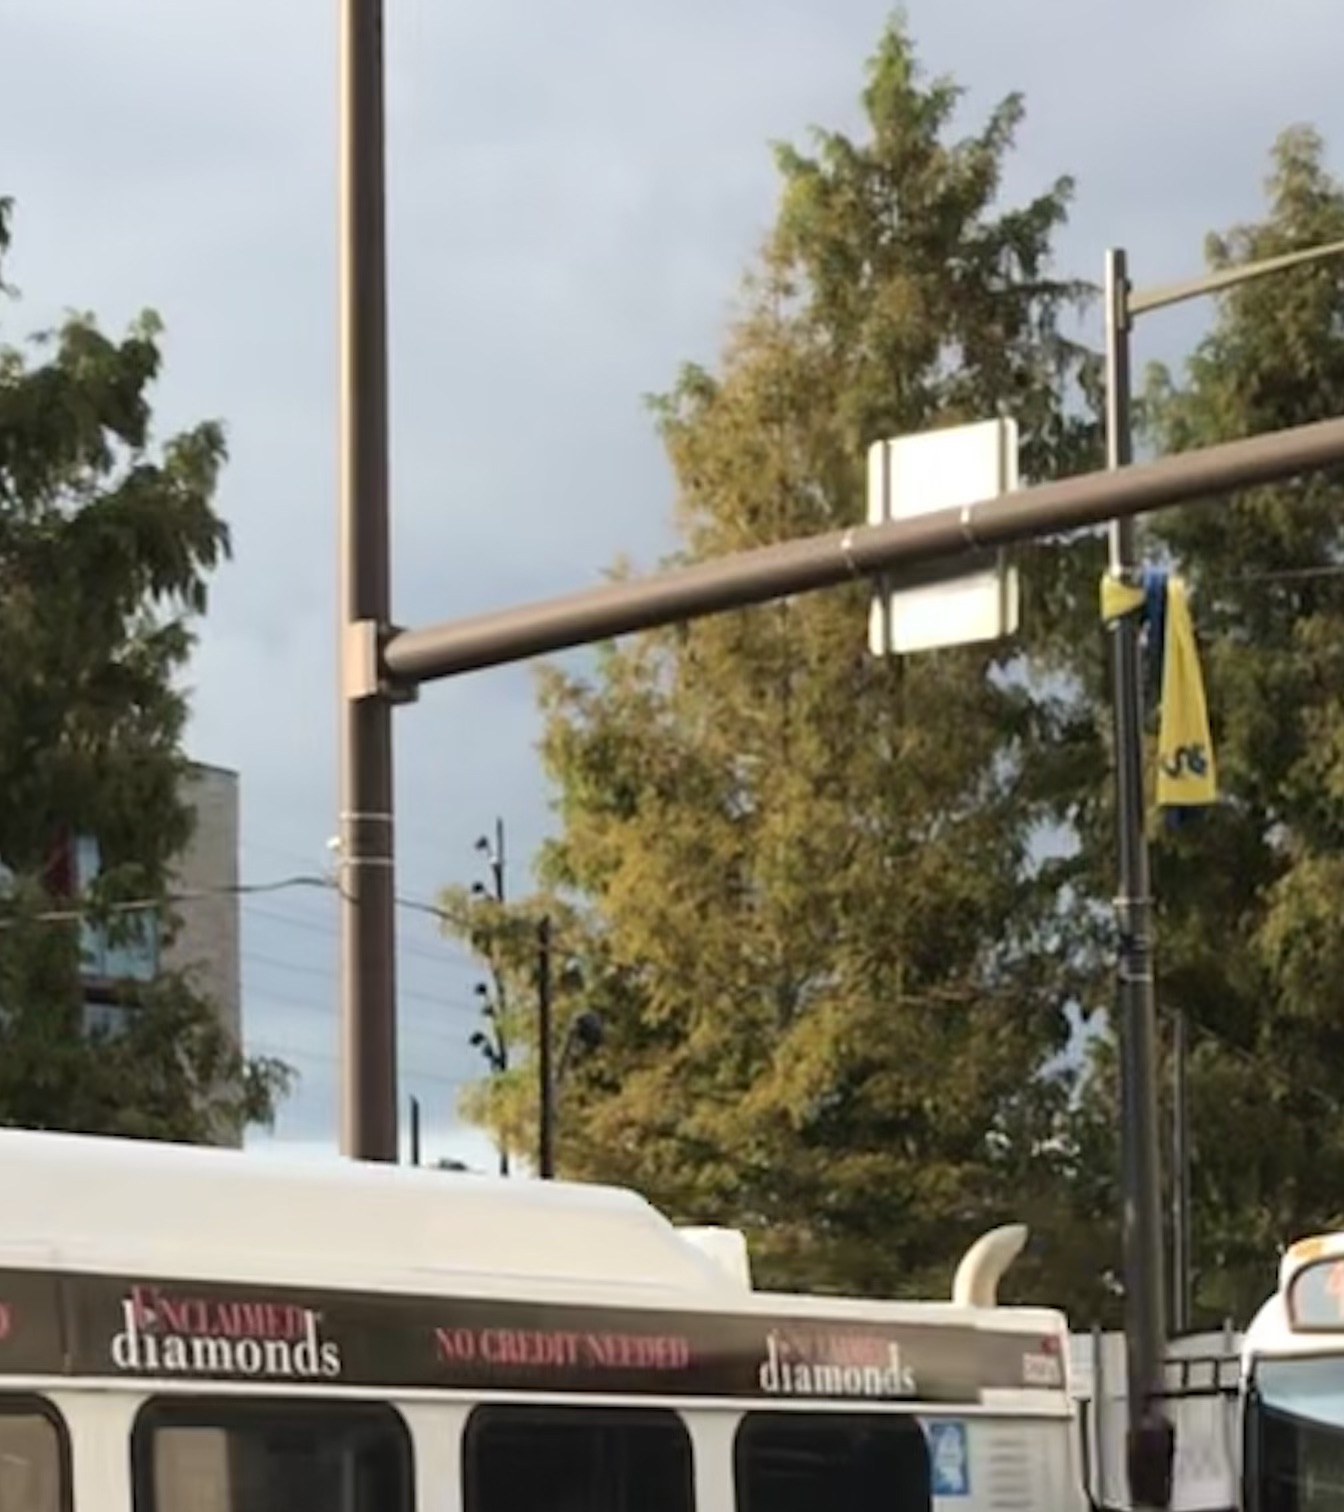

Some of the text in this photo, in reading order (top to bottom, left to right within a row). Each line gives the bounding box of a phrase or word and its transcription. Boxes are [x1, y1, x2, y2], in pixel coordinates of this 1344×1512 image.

[112, 1298, 342, 1377] diamonds
[434, 1327, 473, 1361] NO
[759, 1333, 917, 1395] diamonds
